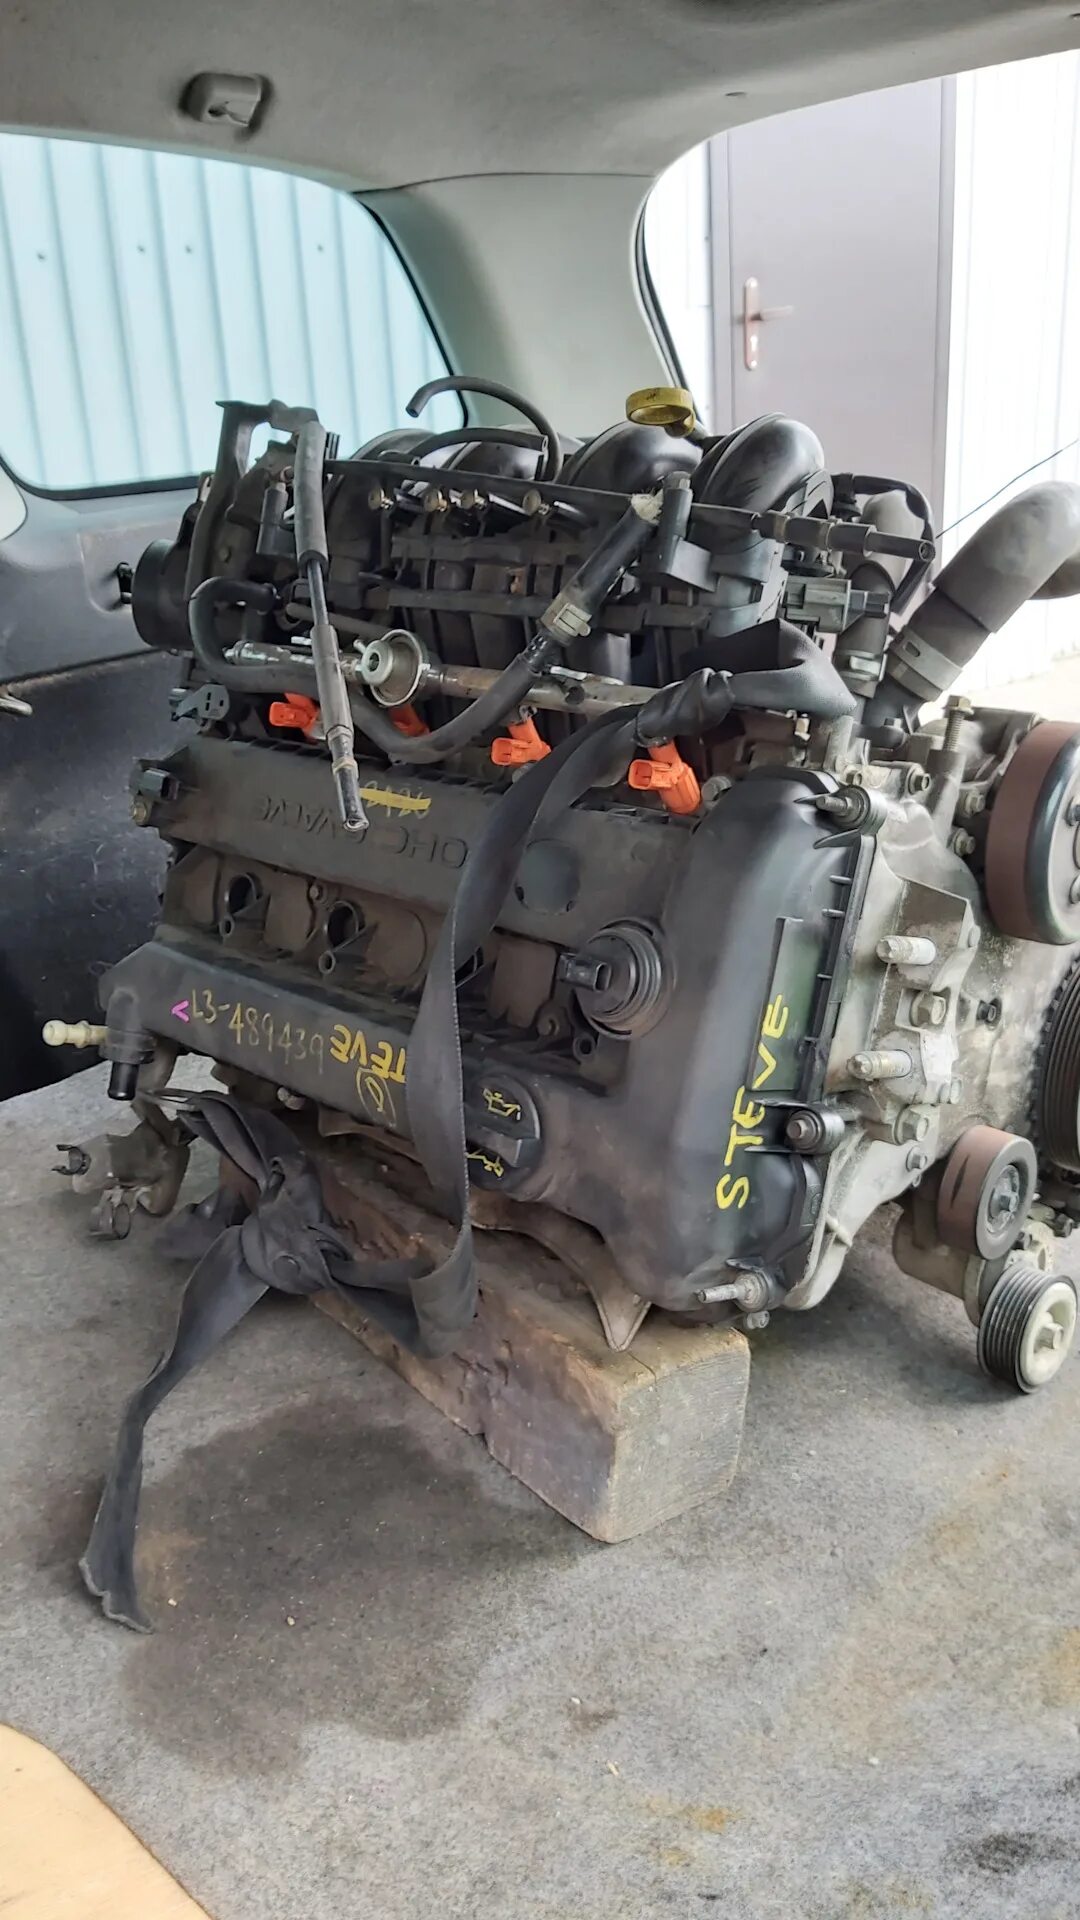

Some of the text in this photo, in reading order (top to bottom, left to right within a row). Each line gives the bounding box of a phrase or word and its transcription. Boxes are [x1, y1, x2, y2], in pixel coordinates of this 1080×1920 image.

[381, 827, 469, 871] OHC
[329, 1023, 408, 1084] TEVE
[716, 994, 790, 1210] STEVE
